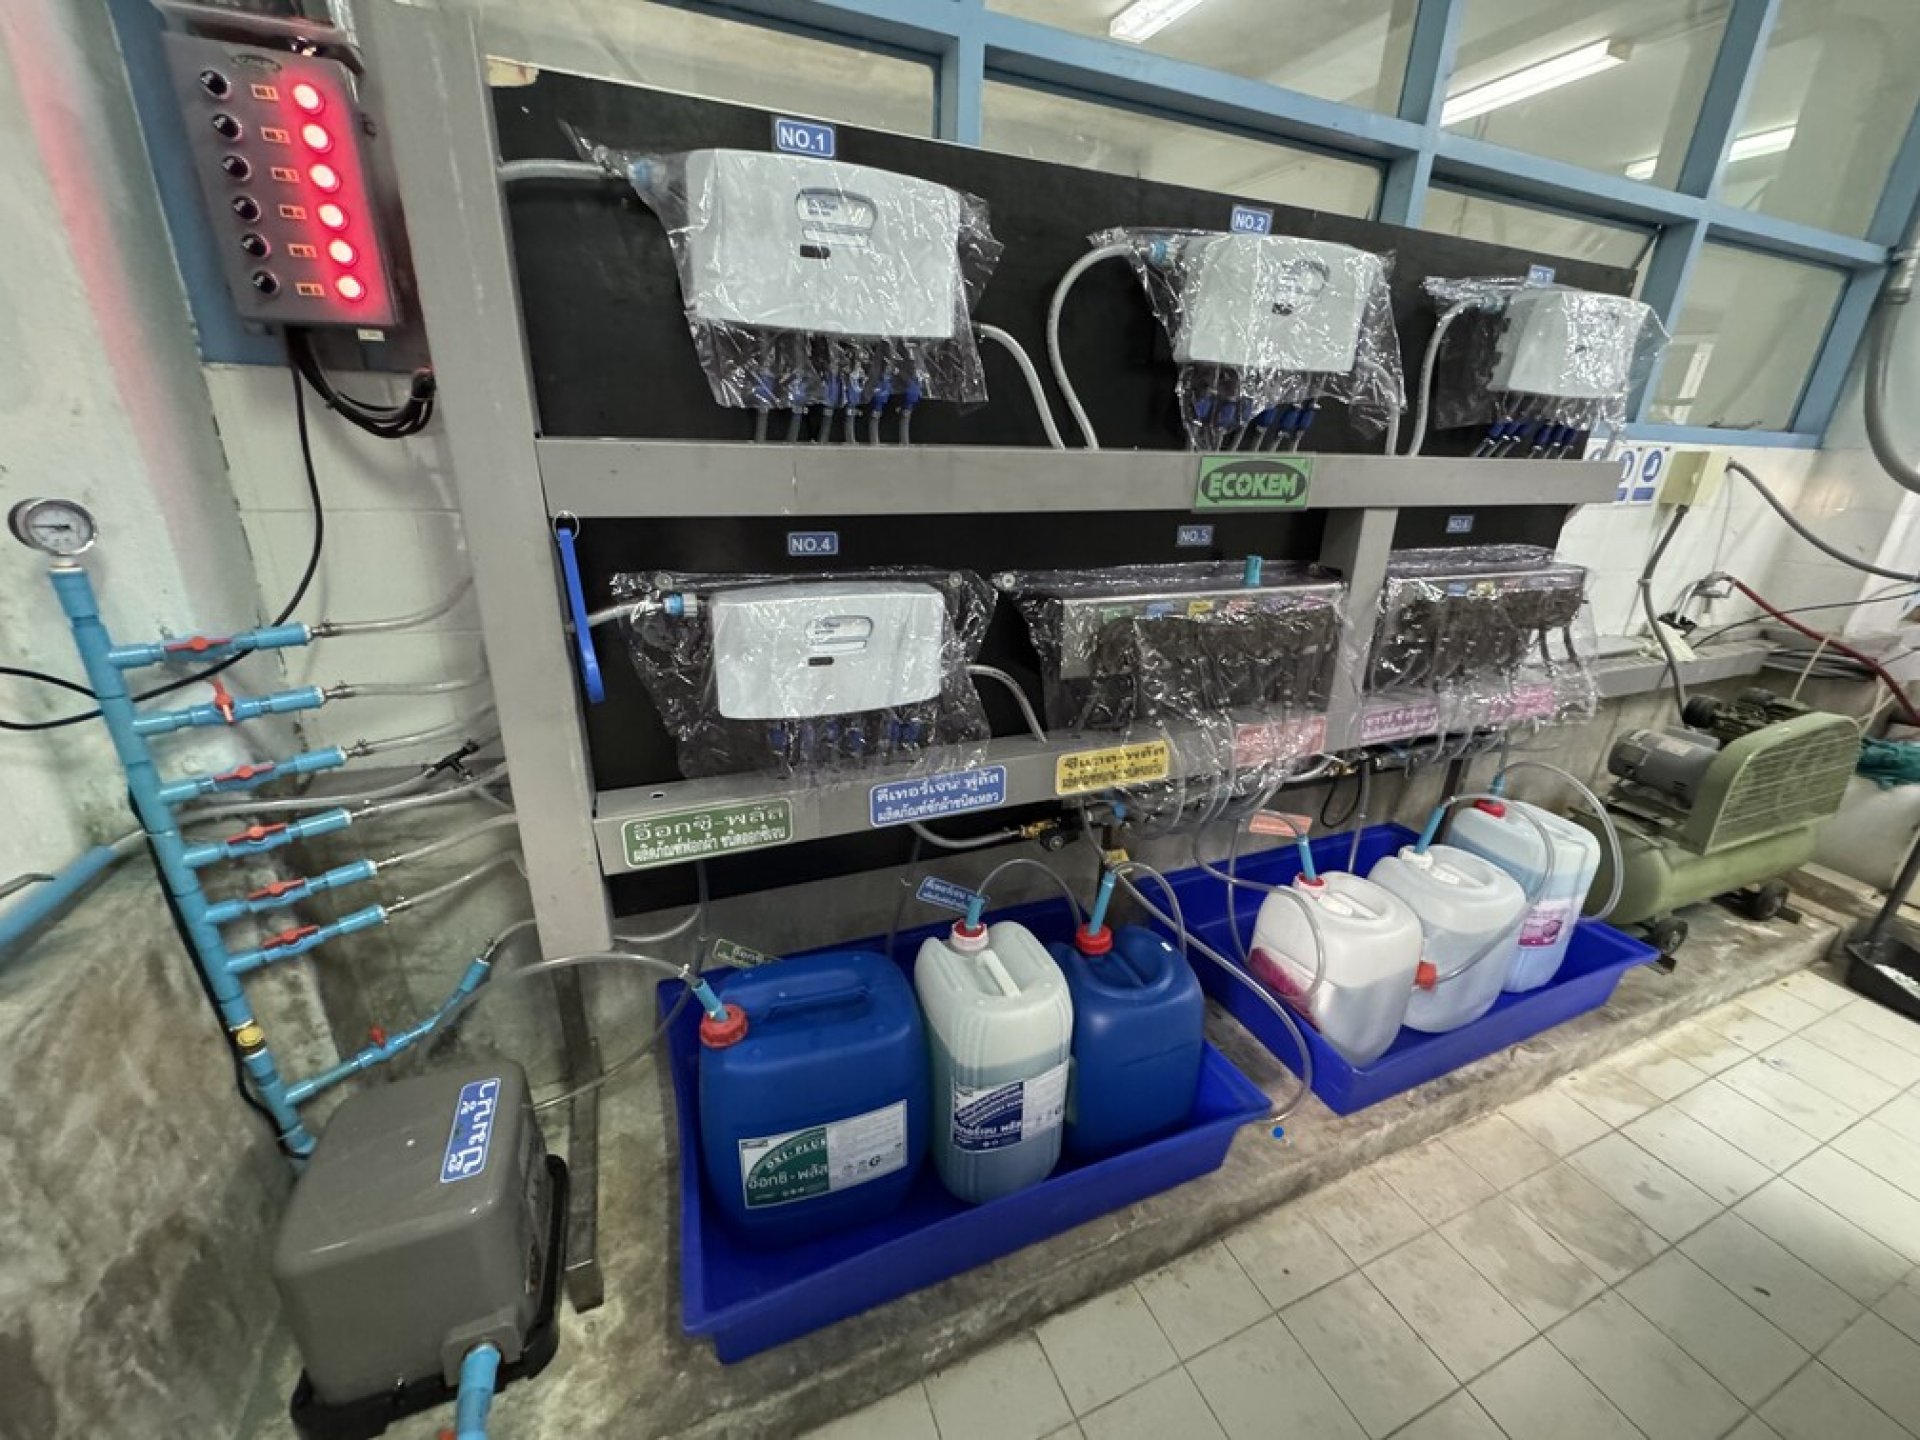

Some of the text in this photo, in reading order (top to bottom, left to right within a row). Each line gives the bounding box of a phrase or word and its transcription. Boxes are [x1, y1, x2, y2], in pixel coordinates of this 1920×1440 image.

[780, 124, 824, 151] NO.1
[1236, 212, 1264, 231] NO.2
[1208, 471, 1298, 497] ECOKEM
[792, 536, 831, 551] NO.4
[1181, 528, 1208, 542] NO.5
